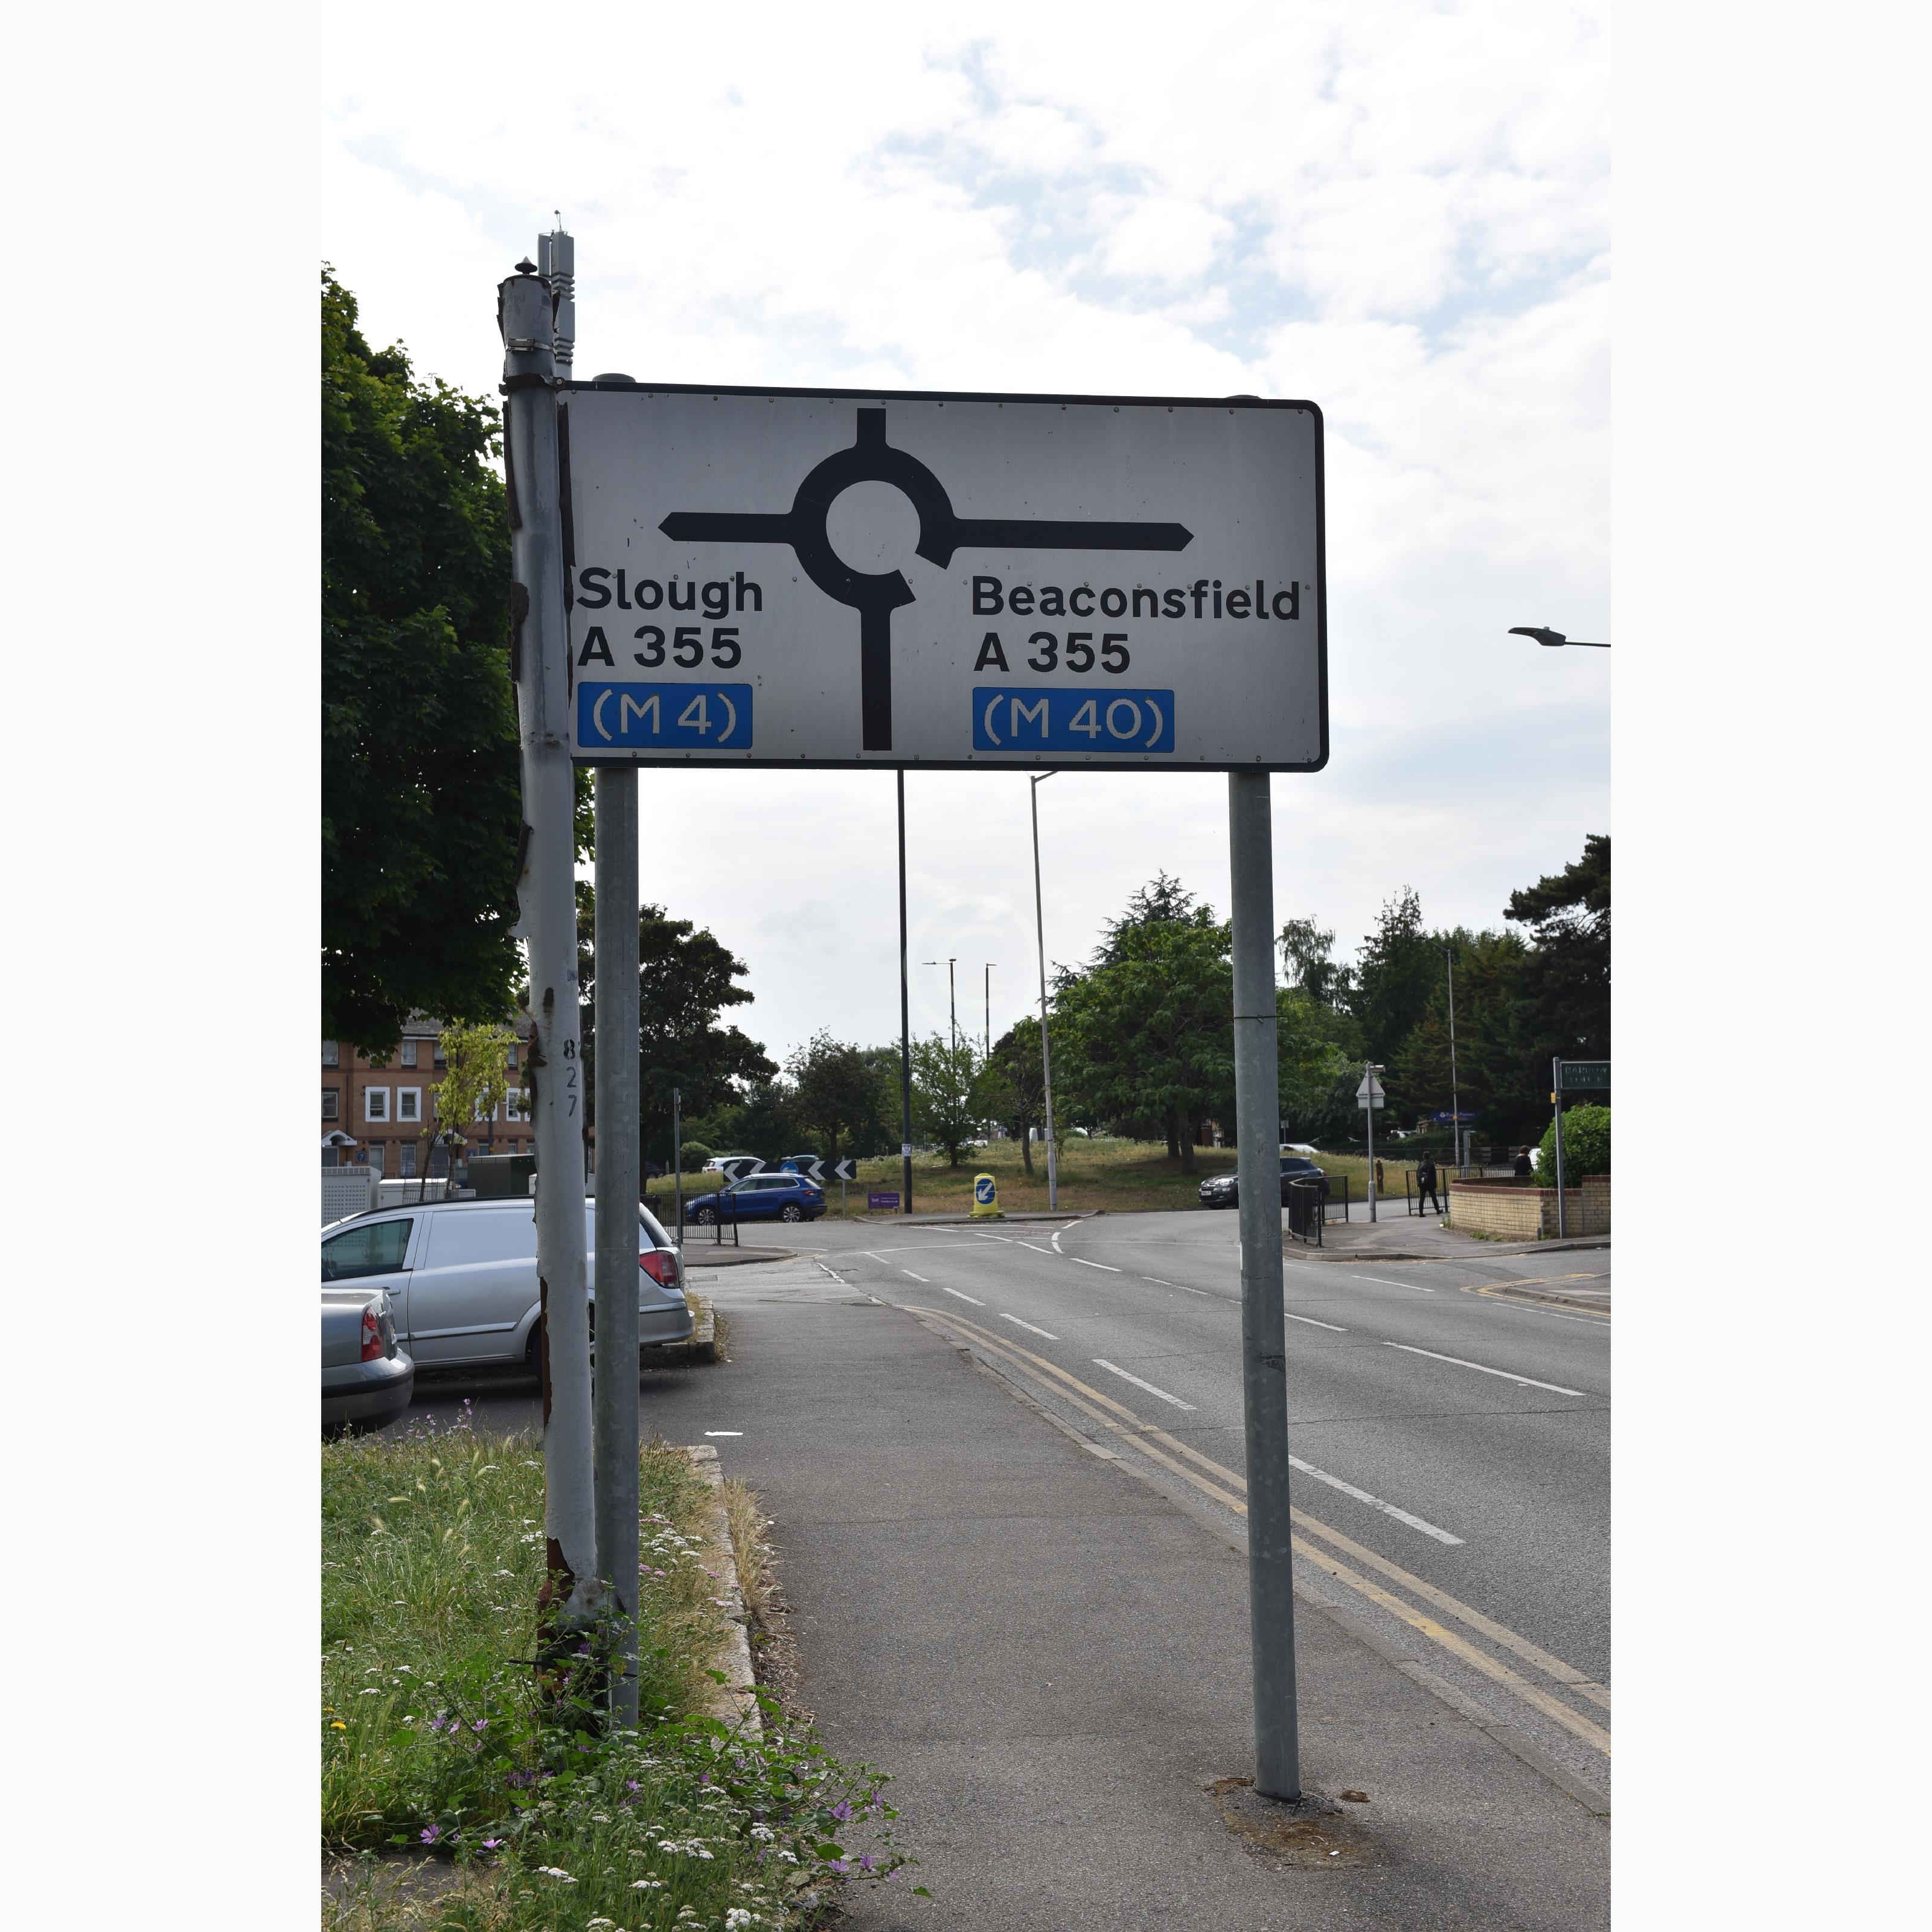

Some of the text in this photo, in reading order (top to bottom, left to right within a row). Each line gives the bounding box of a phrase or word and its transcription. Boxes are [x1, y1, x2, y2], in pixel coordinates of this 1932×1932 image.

[577, 568, 763, 620] Slough
[972, 575, 1300, 621] Beaconsfield
[577, 625, 741, 669] A 355
[973, 631, 1130, 674] A 355
[593, 689, 737, 744] (M 4)
[984, 694, 1163, 748] (M 40)
[563, 1038, 578, 1118] 827
